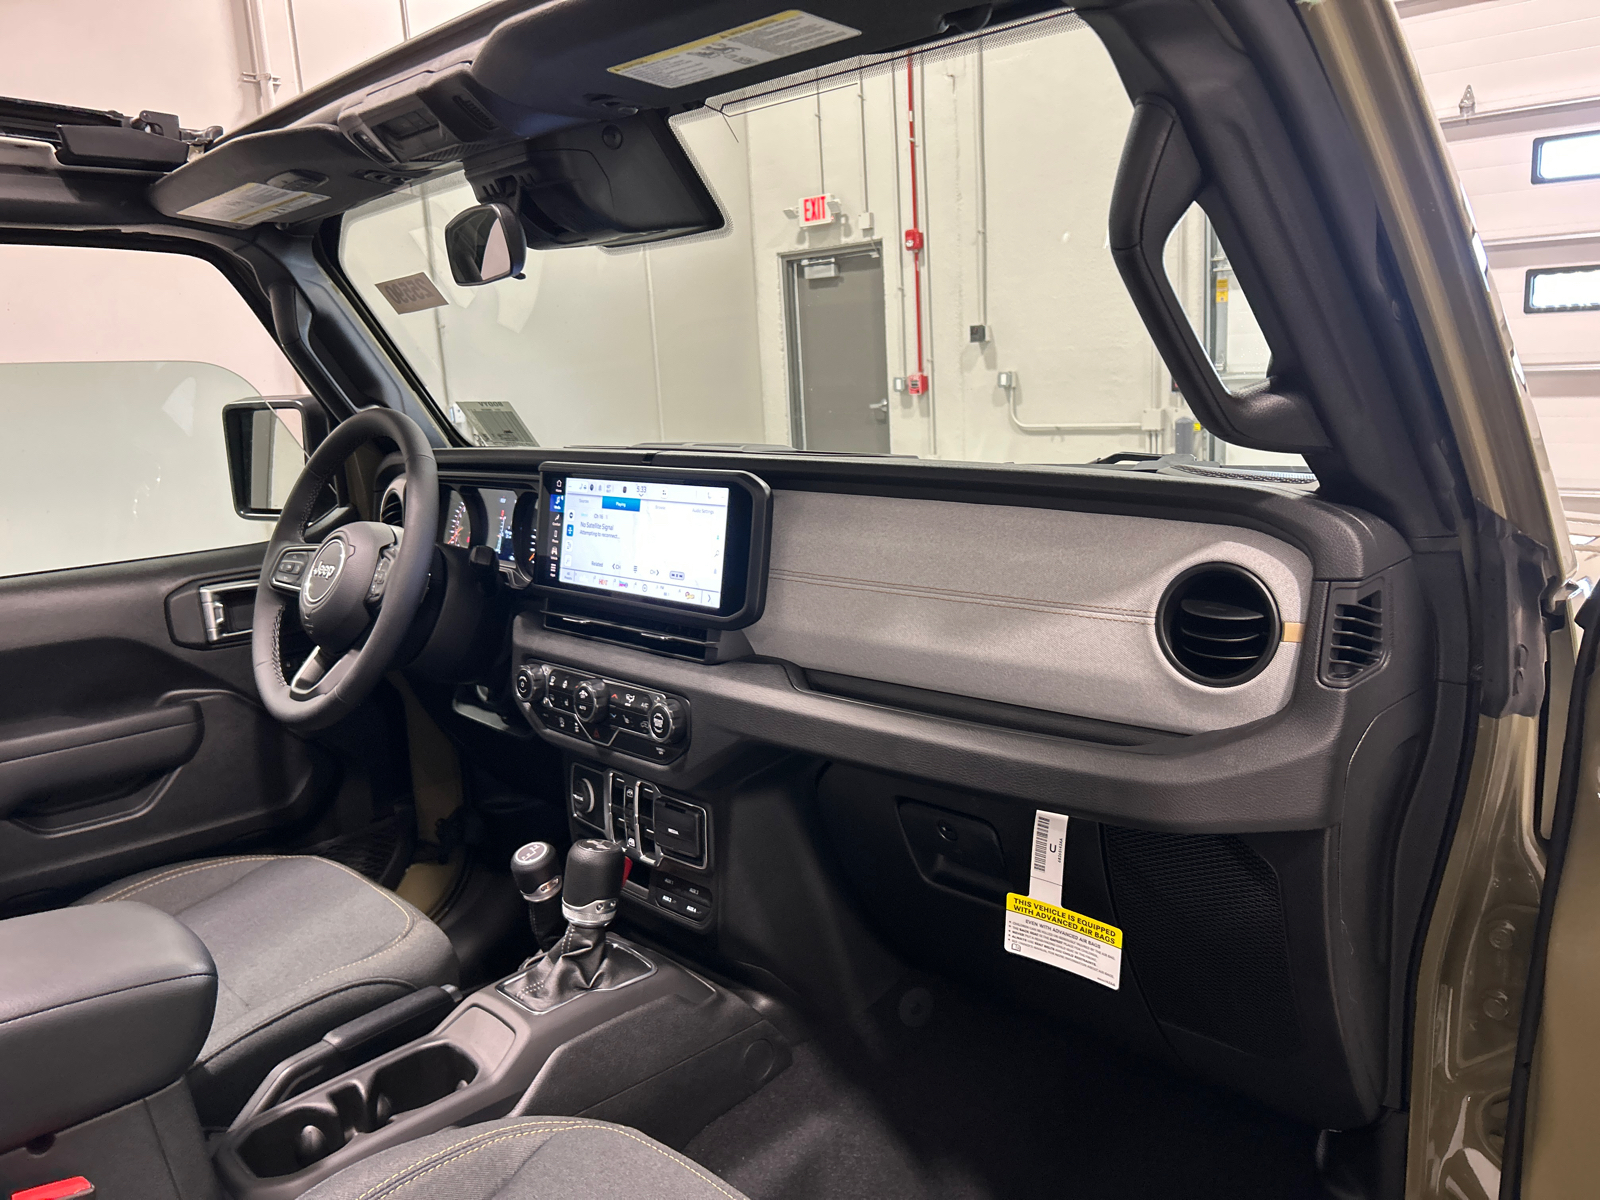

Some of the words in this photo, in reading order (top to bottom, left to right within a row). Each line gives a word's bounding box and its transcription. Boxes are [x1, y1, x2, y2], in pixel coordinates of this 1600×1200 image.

[803, 195, 826, 222] EXIT
[586, 521, 601, 530] Satellite
[602, 523, 614, 531] Signal
[1049, 843, 1057, 853] U
[1013, 904, 1034, 915] WITH
[1036, 911, 1078, 930] ADVANCED
[1080, 926, 1093, 936] AIR
[1094, 931, 1116, 945] BAGS
[1014, 897, 1032, 907] THIS
[1033, 903, 1066, 918] VEHICLE
[1067, 914, 1075, 922] IS
[1077, 917, 1116, 937] EQUIPPED
[1039, 923, 1052, 931] WITH
[1052, 927, 1079, 941] ADVANCED
[1088, 940, 1101, 949] BAGS
